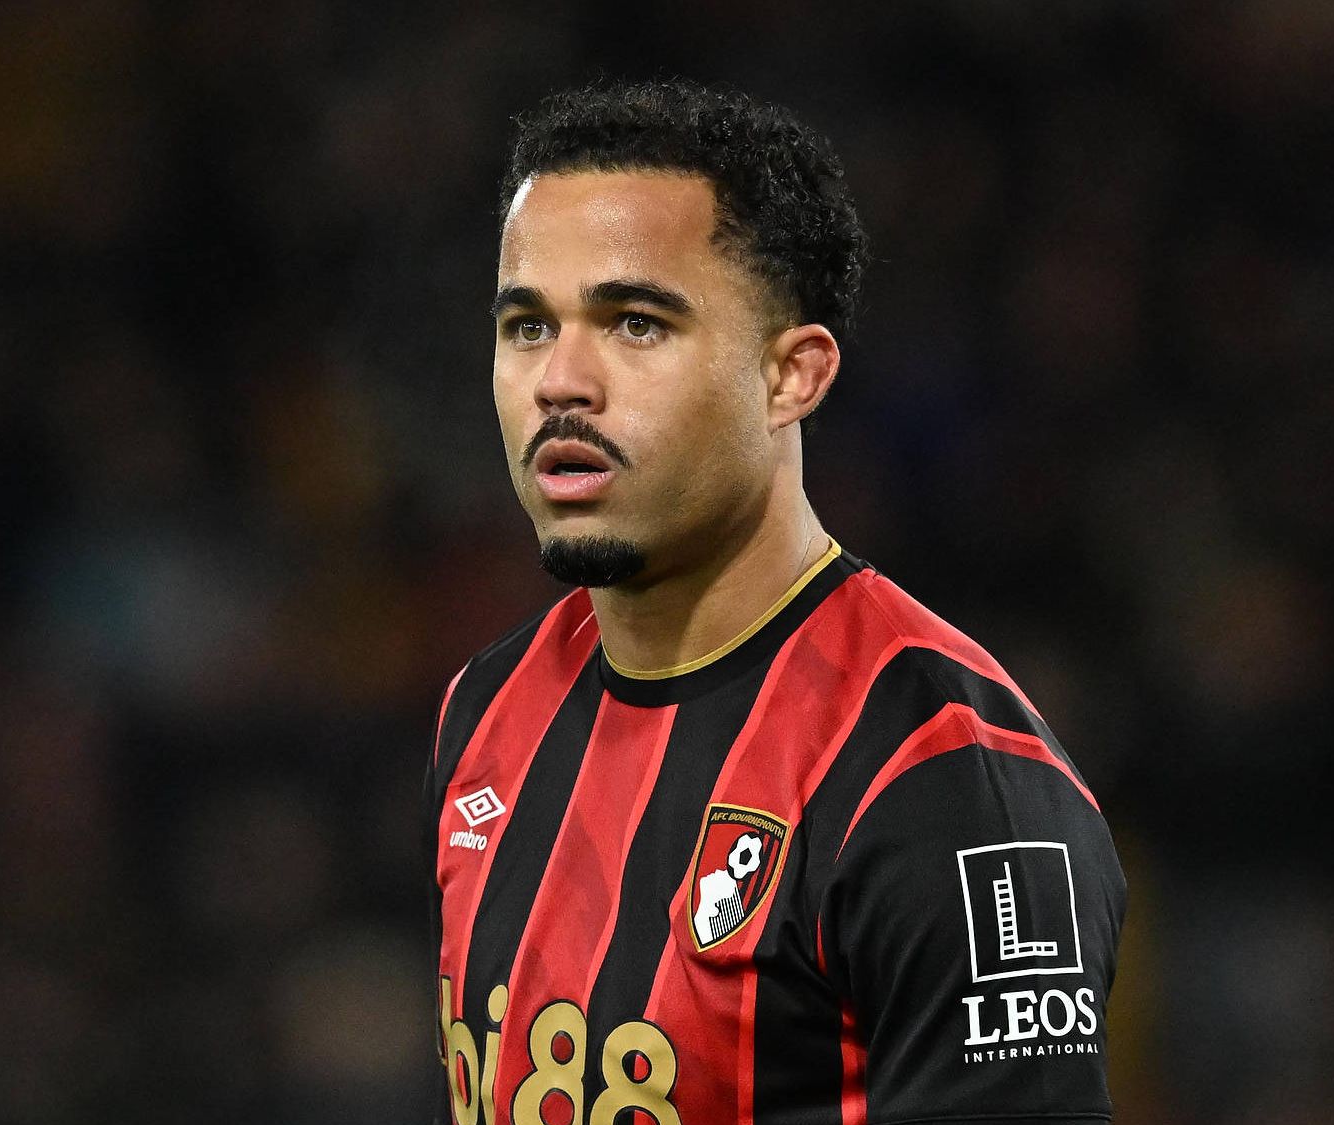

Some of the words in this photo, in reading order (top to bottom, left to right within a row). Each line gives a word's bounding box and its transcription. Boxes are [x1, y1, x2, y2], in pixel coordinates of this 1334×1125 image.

[711, 812, 729, 821] AFC
[728, 812, 785, 838] BOURNEMOUTH
[450, 829, 488, 851] umbro
[962, 988, 1097, 1046] LEOS
[965, 1043, 1099, 1063] INTERNATIONAL
